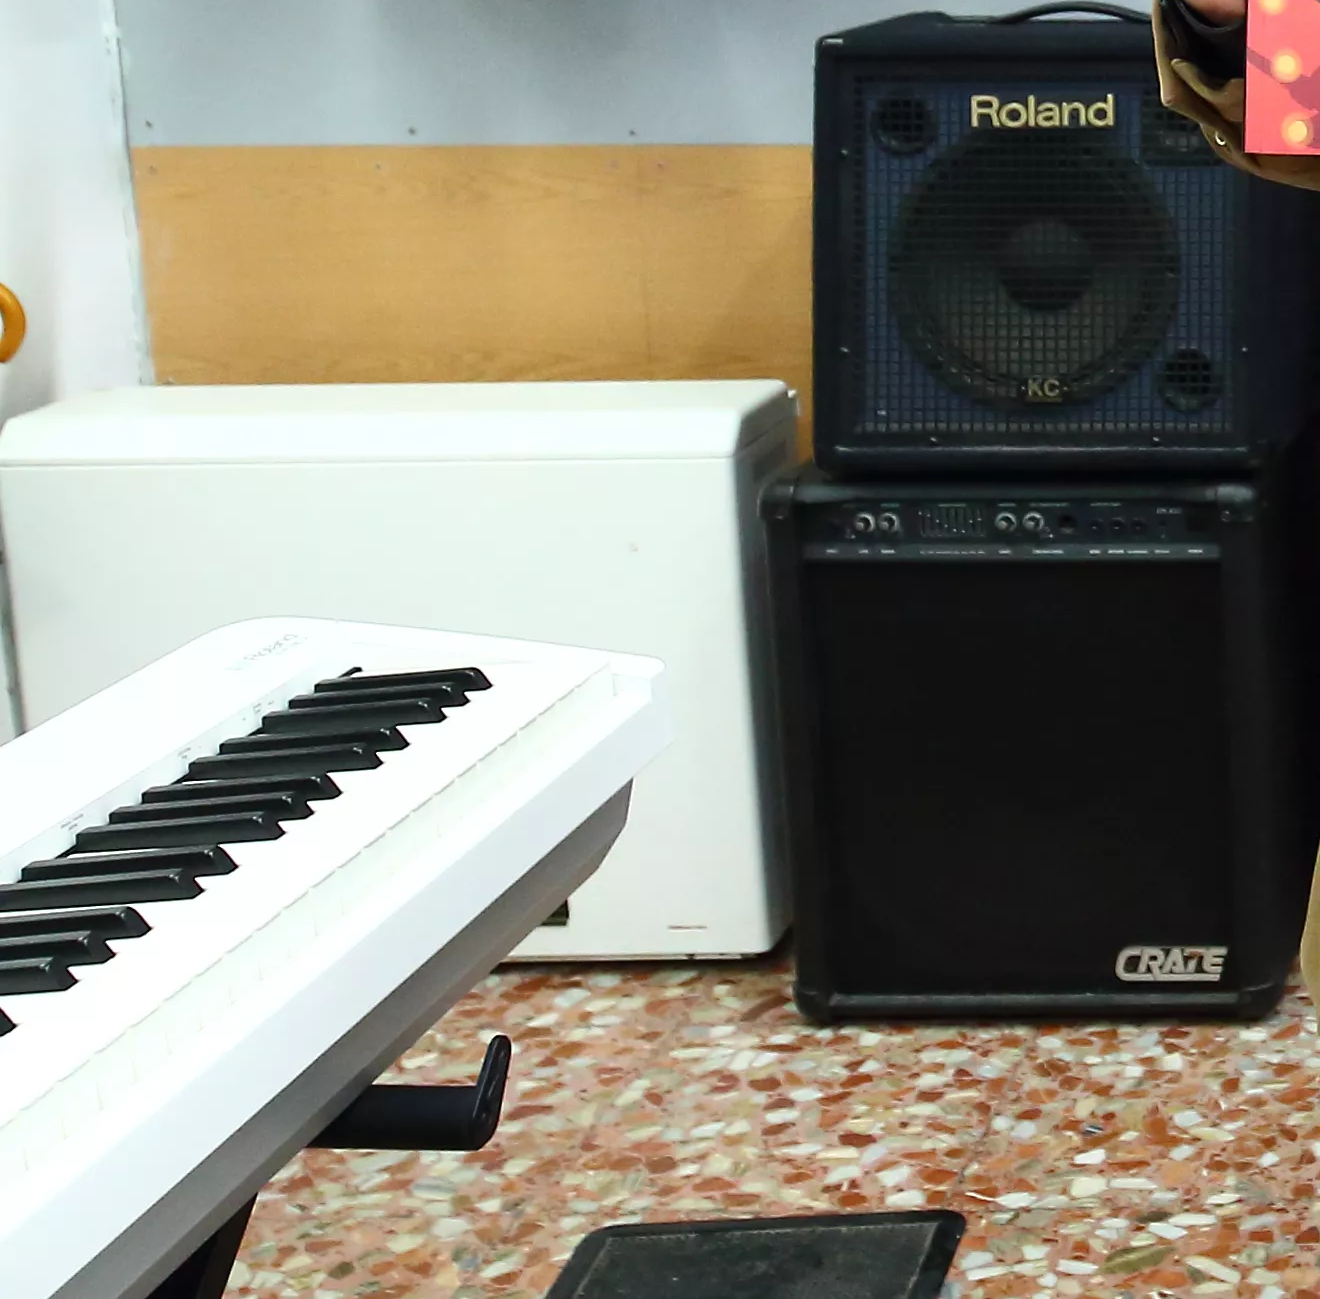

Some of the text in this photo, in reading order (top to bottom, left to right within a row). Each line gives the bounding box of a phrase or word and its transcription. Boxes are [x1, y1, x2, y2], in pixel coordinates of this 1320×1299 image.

[970, 93, 1114, 129] Roland
[1026, 378, 1060, 398] KC
[1114, 946, 1228, 982] CRATE
